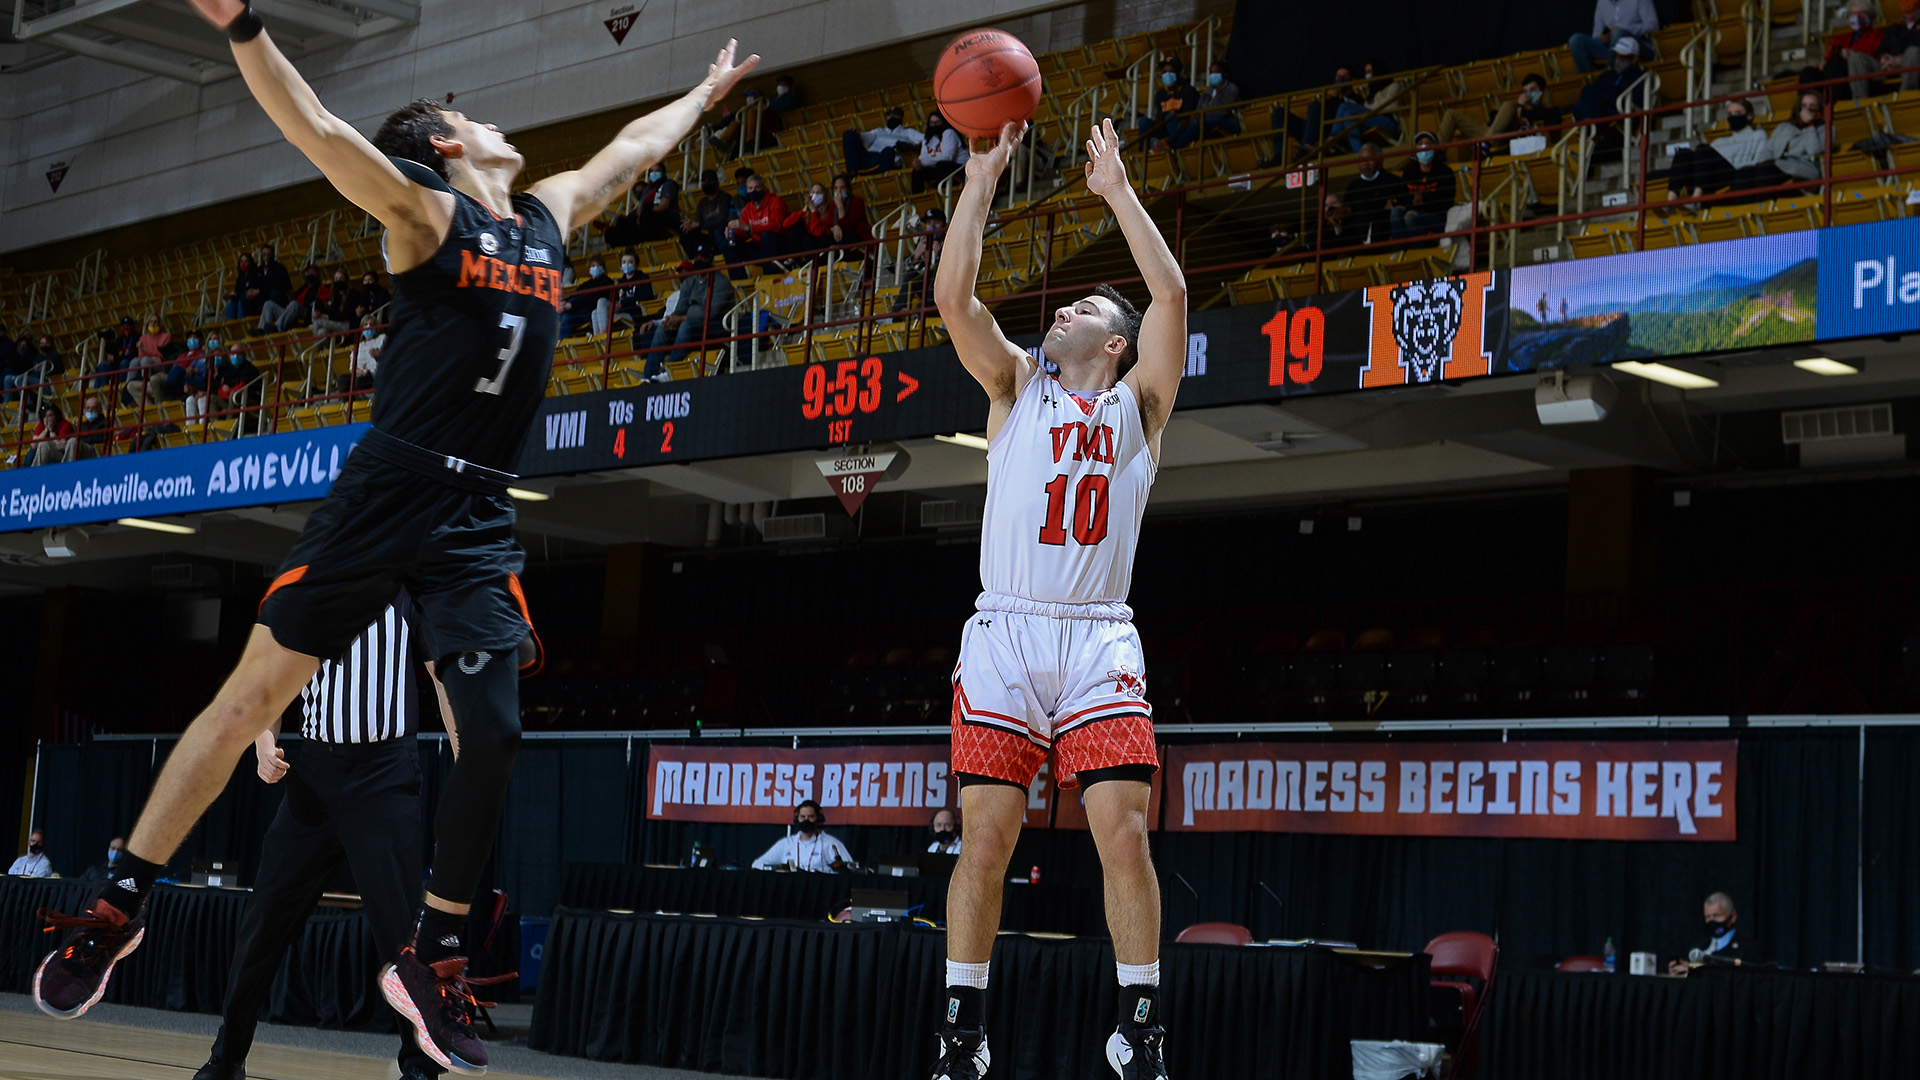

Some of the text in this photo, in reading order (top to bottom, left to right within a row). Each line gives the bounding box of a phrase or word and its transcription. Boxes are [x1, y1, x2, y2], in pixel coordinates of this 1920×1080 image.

[612, 17, 629, 32] 210
[1854, 255, 1920, 309] Pla
[474, 312, 528, 395] 3
[1261, 306, 1325, 386] 19
[609, 391, 691, 426] TOs FOULS
[802, 357, 883, 420] 9:53
[546, 410, 587, 450] VMI
[613, 421, 674, 459] 4 2
[828, 419, 852, 443] 1ST
[1049, 421, 1114, 465] VMI
[834, 457, 875, 472] SECTION
[841, 475, 865, 494] 108
[9, 472, 196, 522] ExploreAsheville.com.
[1038, 474, 1110, 546] 10
[652, 761, 815, 816] MADNESS
[820, 761, 948, 808] BEGINS
[1182, 760, 1723, 834] MADNESS BEGINS HERE
